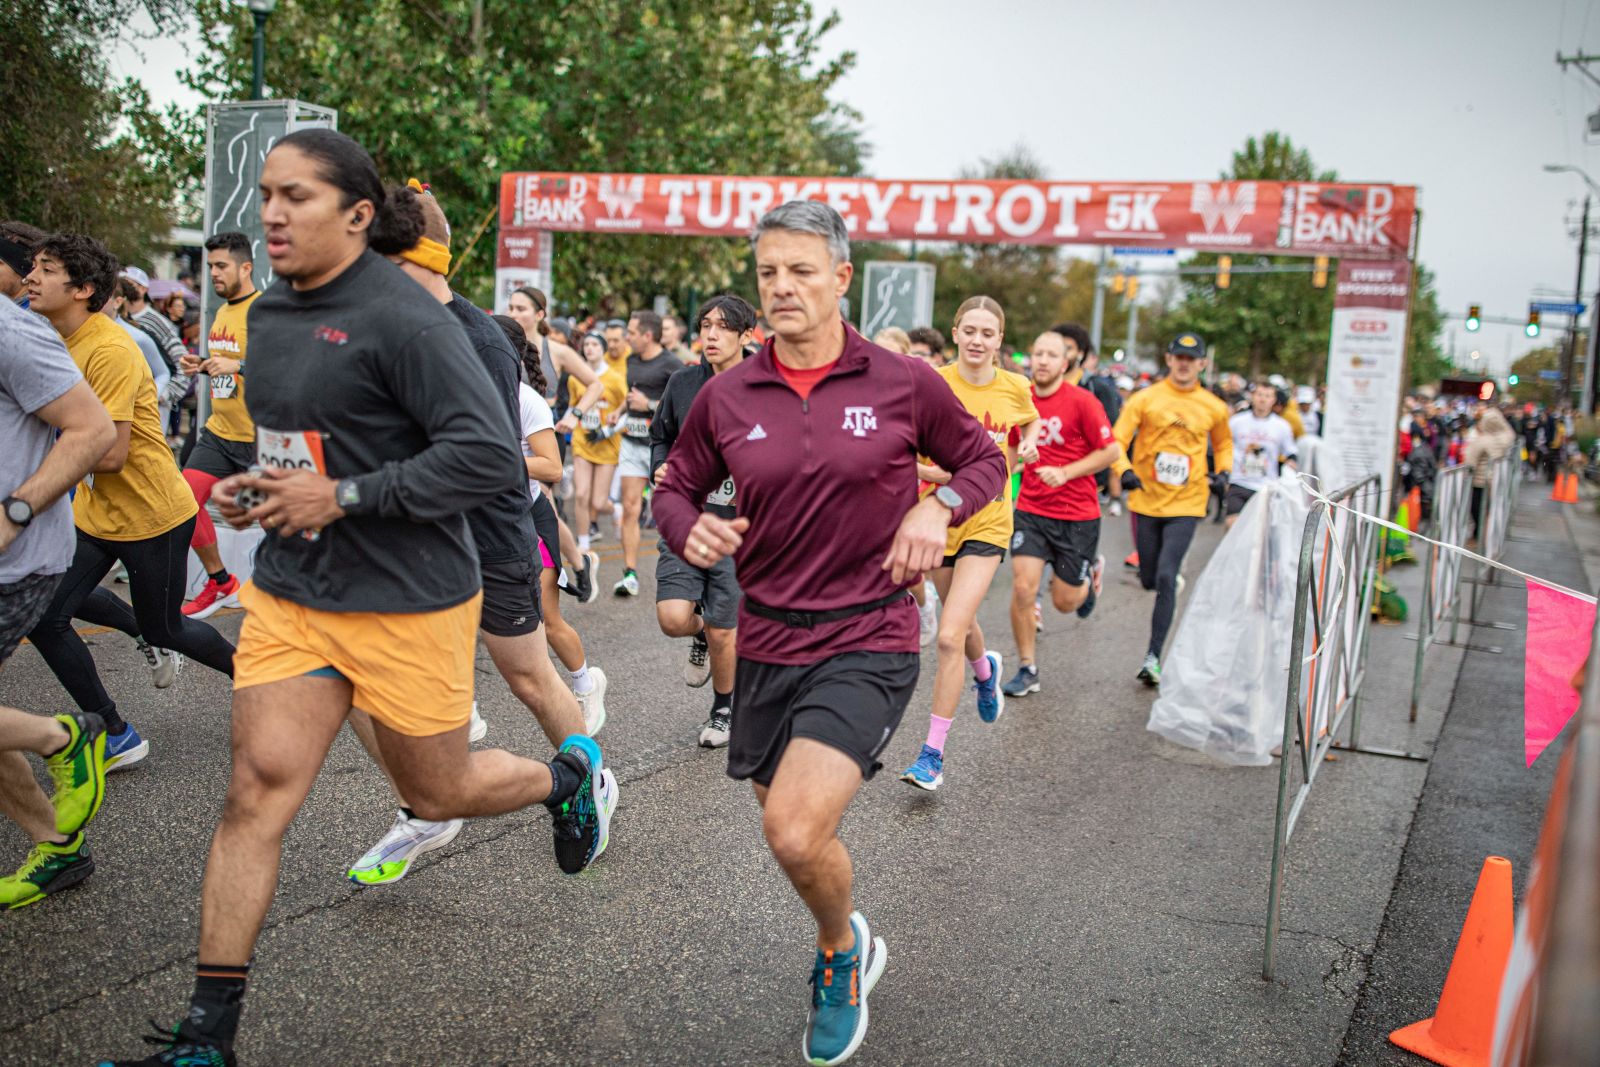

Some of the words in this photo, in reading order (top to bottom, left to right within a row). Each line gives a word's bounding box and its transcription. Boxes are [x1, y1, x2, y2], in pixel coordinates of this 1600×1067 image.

[523, 198, 586, 222] BANK
[909, 183, 1092, 238] TROT
[1105, 193, 1161, 232] 5K
[1294, 212, 1392, 246] BANK
[1157, 462, 1186, 475] 5491
